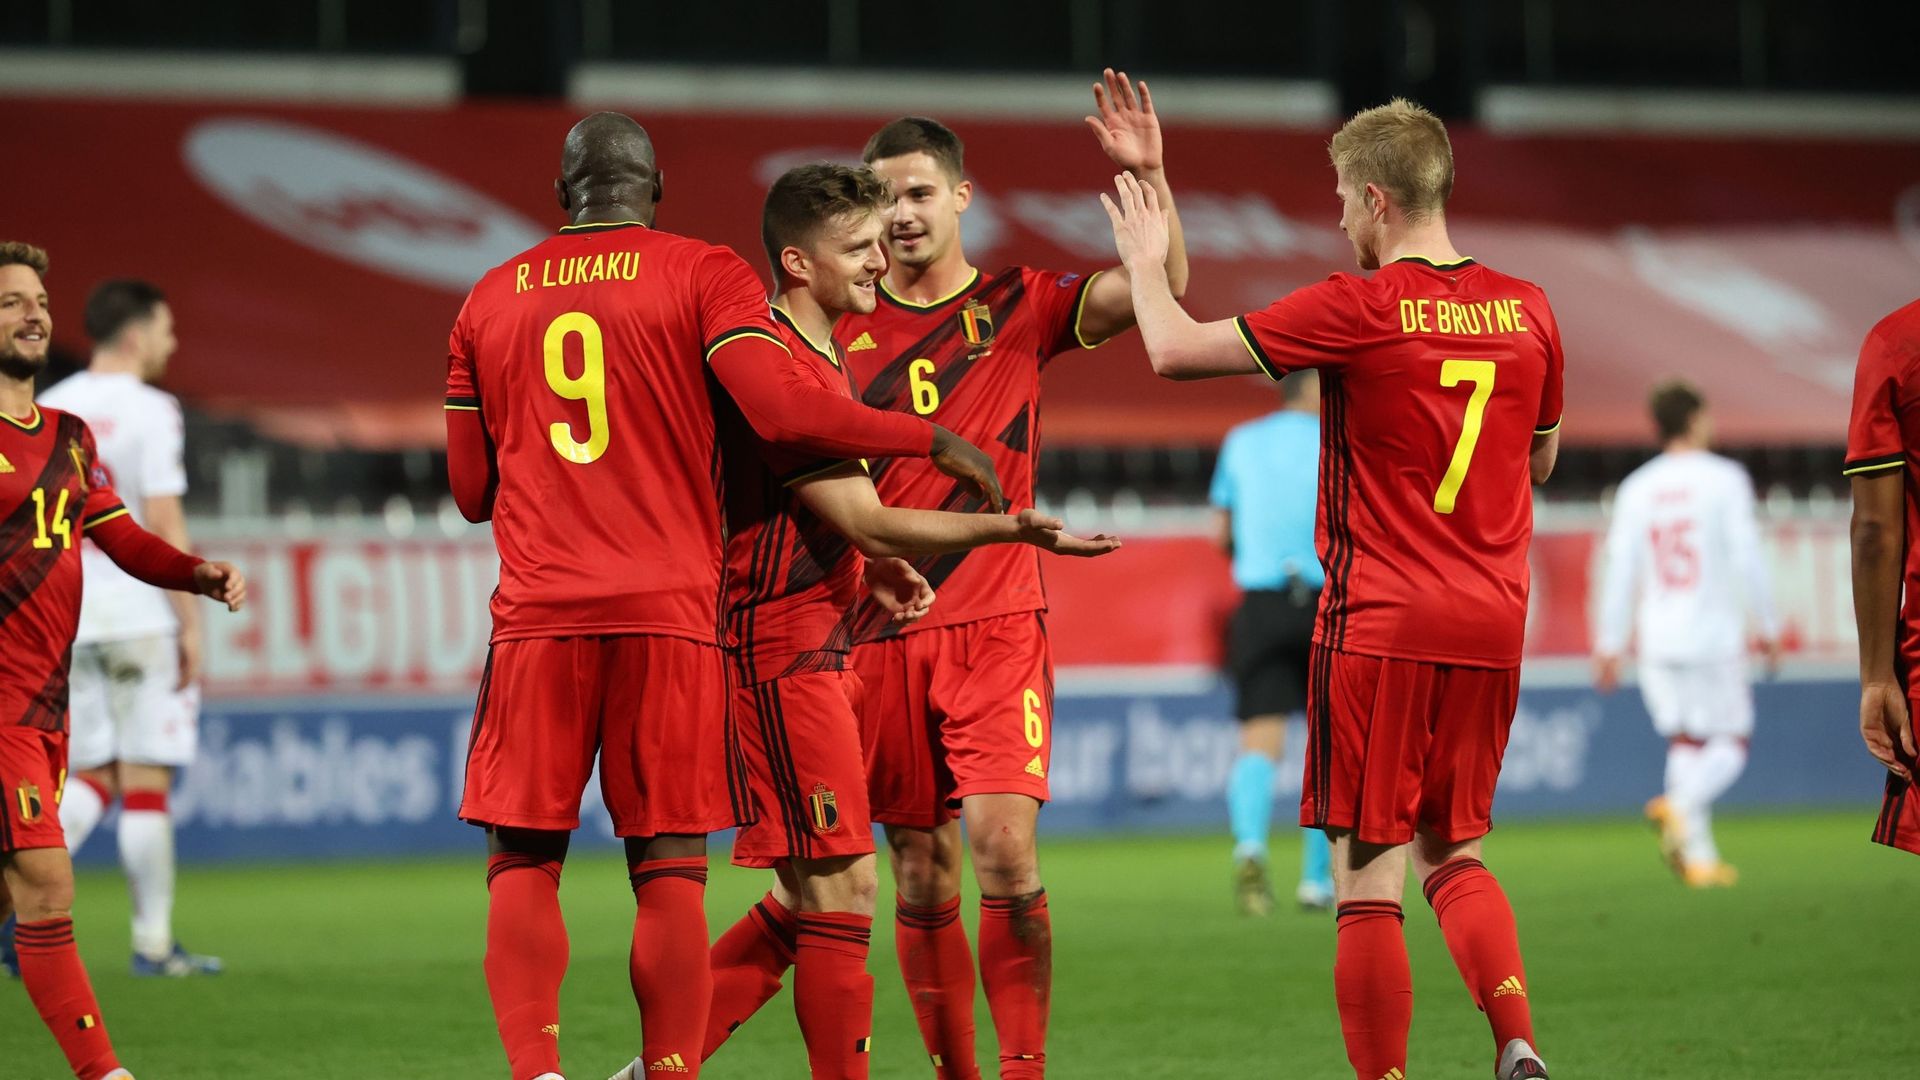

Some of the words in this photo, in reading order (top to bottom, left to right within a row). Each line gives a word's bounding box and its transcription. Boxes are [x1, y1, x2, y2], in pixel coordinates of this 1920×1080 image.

[516, 262, 534, 294] R.
[542, 251, 640, 288] LUKAKU
[1400, 299, 1432, 334] DE
[1436, 299, 1528, 335] BRUYNE
[543, 311, 610, 465] 9
[908, 358, 940, 416] 6
[1433, 359, 1497, 515] 7
[31, 487, 72, 550] 14
[203, 552, 494, 676] ELGIU
[1023, 688, 1043, 749] 6
[650, 1064, 689, 1073] adidas
